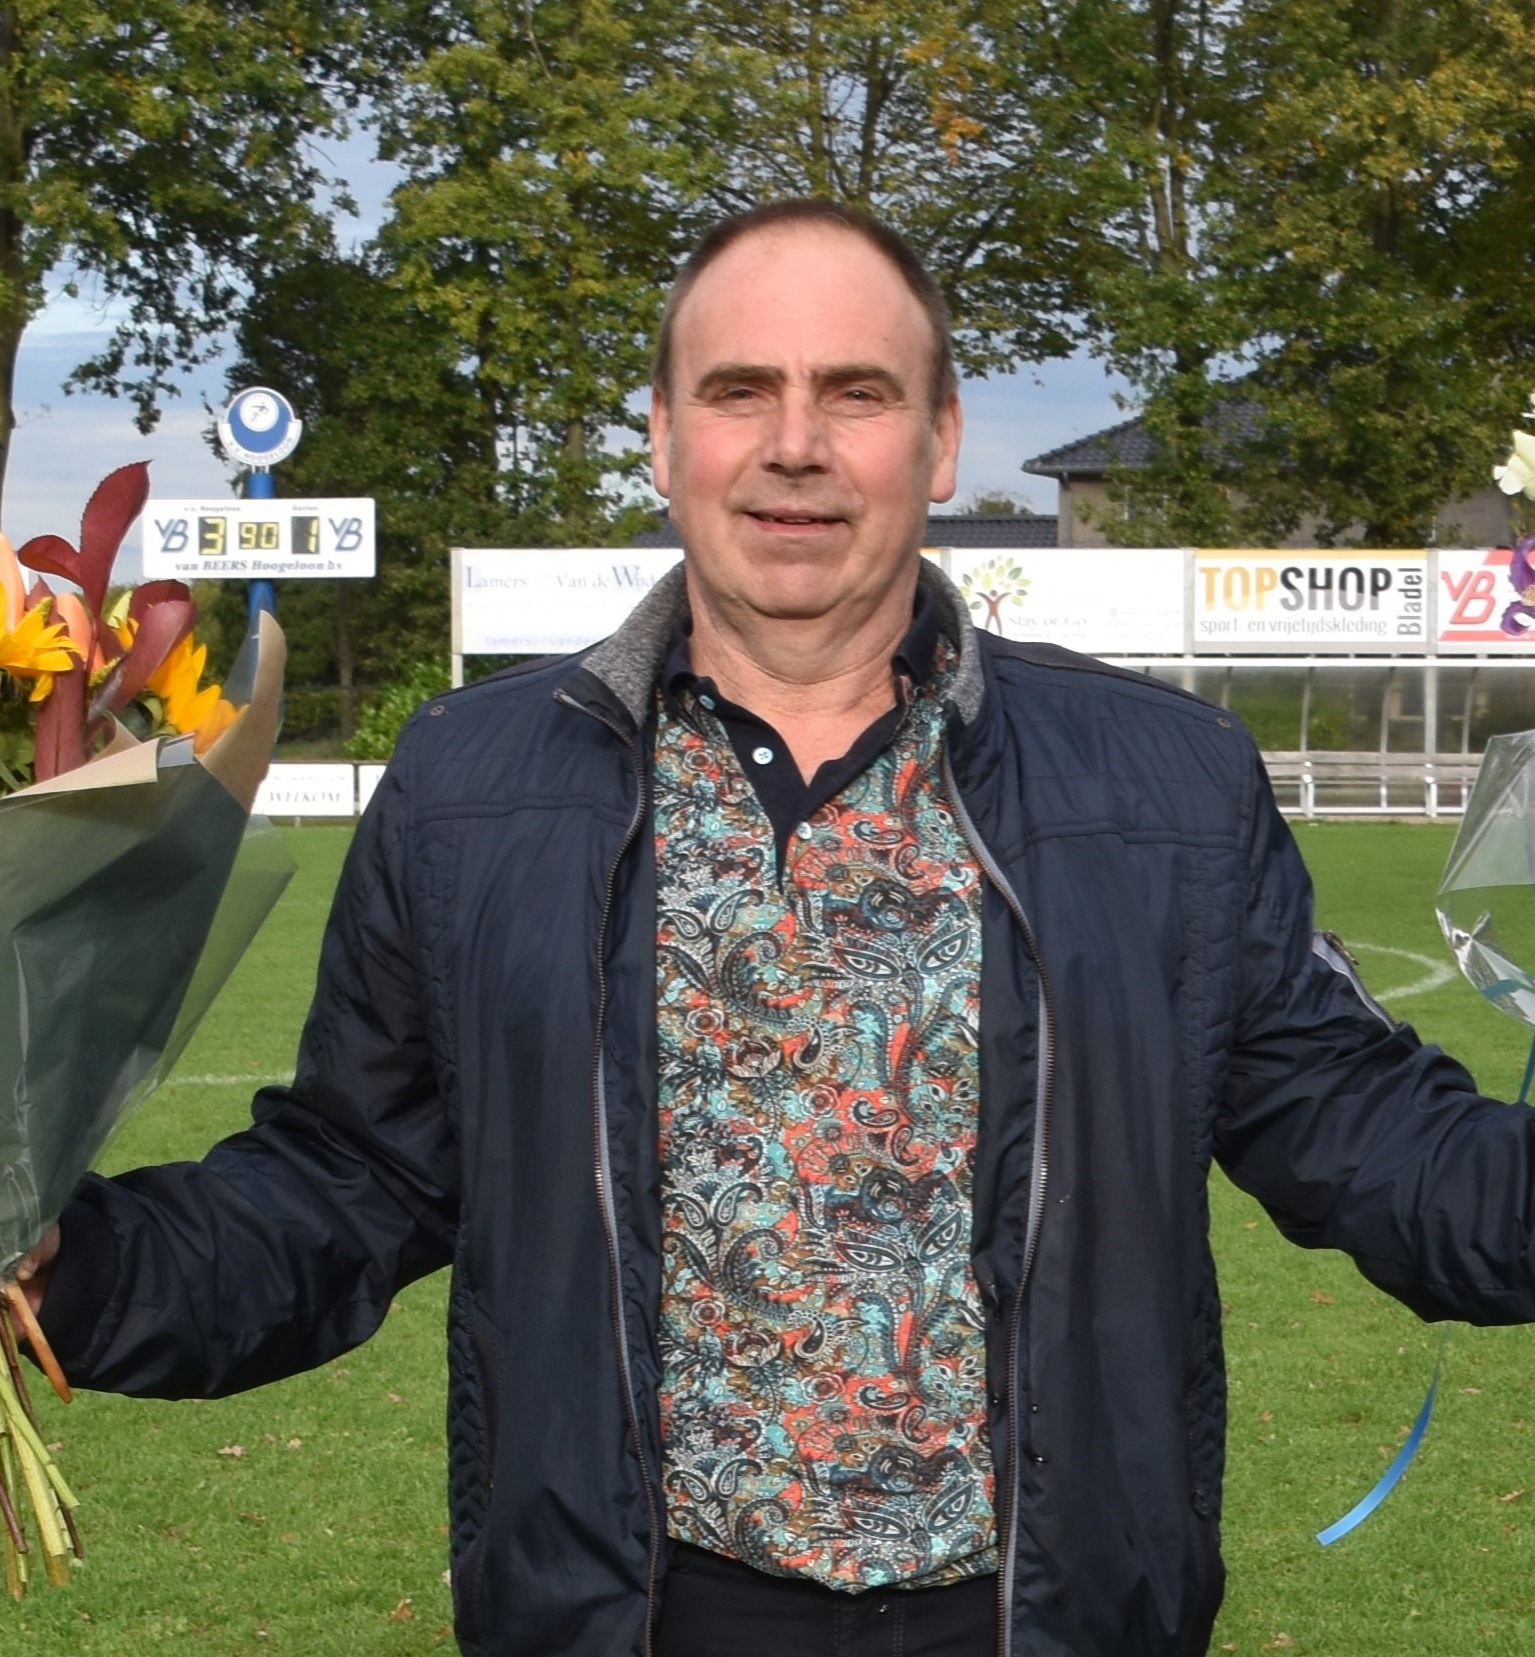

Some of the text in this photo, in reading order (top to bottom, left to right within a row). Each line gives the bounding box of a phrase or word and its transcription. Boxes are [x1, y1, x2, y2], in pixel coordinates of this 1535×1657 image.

[199, 516, 225, 555] 3
[239, 523, 278, 549] 90
[307, 519, 319, 553] 1
[175, 563, 198, 572] van
[202, 560, 248, 571] BEERS
[251, 560, 324, 574] Hoogeloon
[465, 566, 528, 588] Lamers
[555, 574, 587, 588] Van
[591, 573, 611, 588] de
[1199, 566, 1393, 612] TOPSHOP
[1397, 567, 1423, 636] Bladel
[1247, 618, 1266, 633] en
[1269, 617, 1388, 636] vrijetijdskleding
